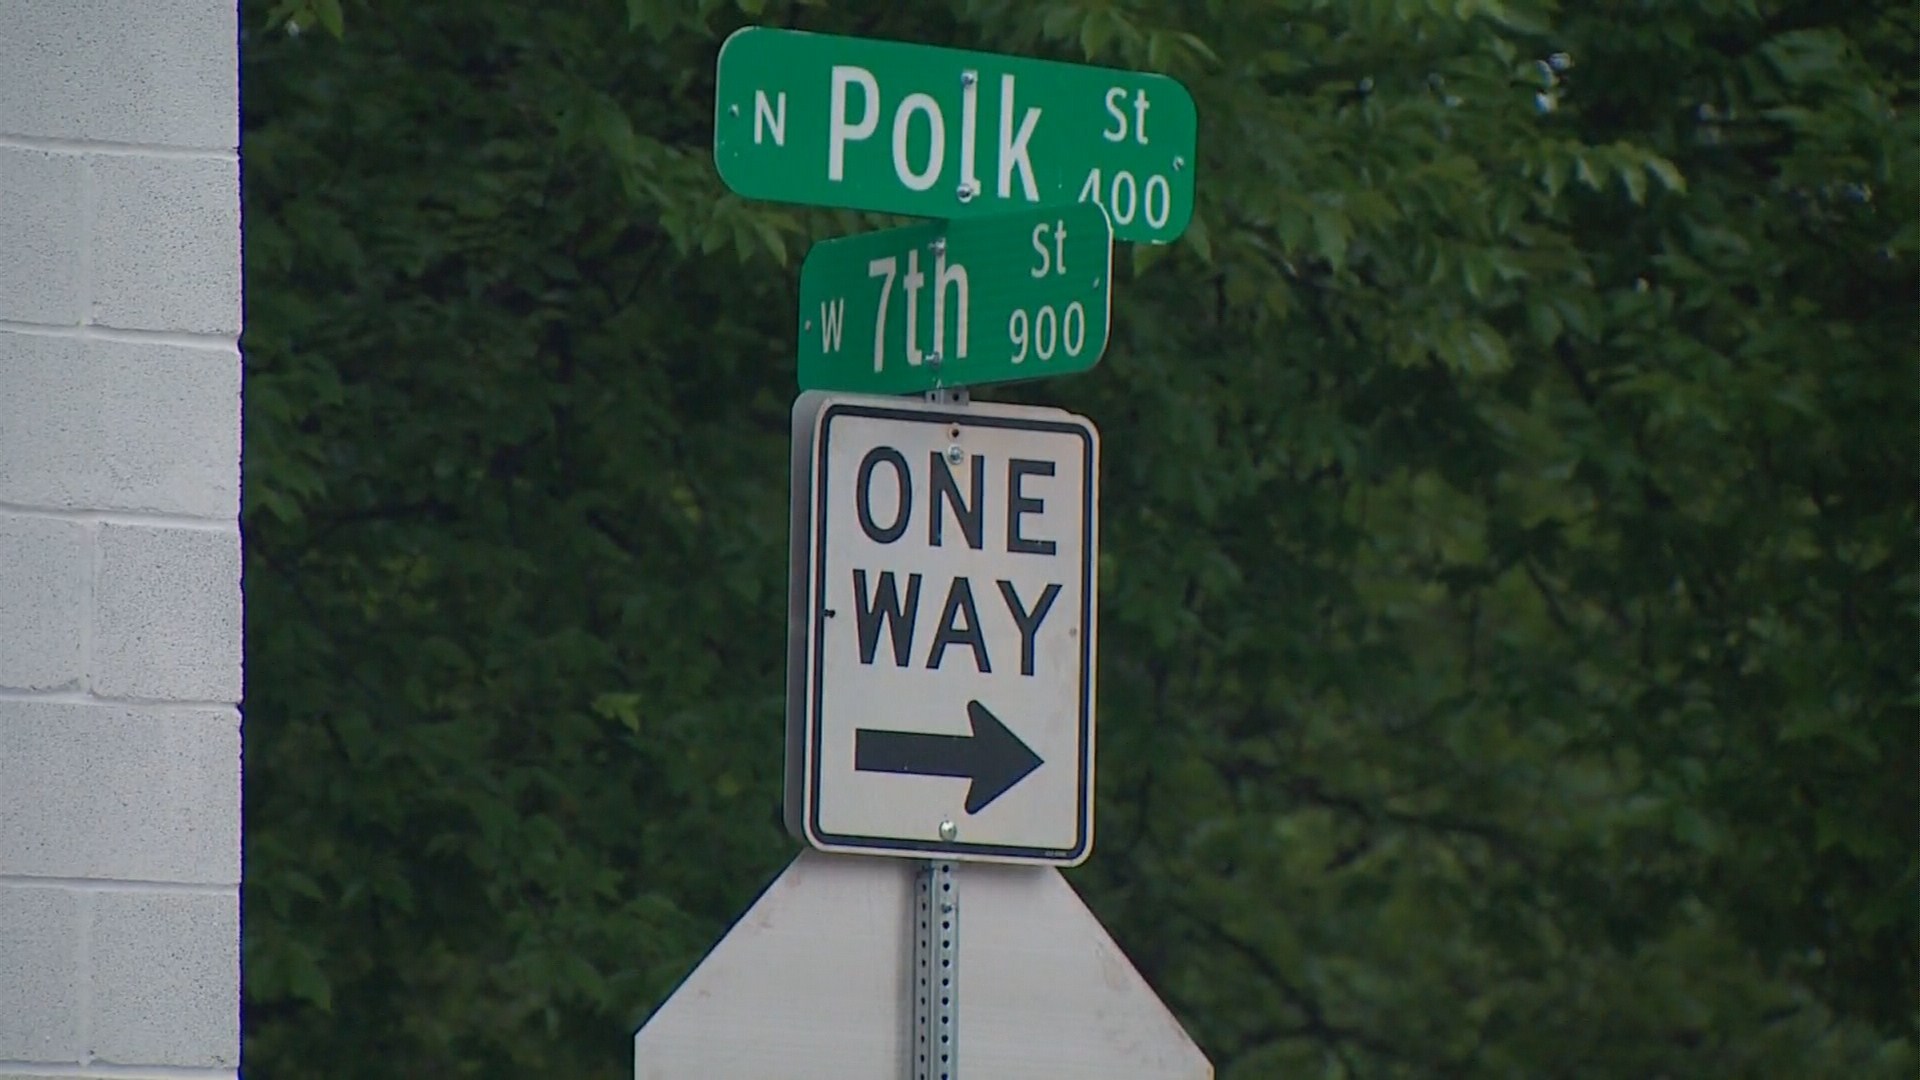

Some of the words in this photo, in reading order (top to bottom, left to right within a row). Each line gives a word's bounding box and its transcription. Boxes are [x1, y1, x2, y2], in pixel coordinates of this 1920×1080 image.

[754, 90, 786, 146] N
[828, 65, 1042, 202] Polk
[1103, 86, 1150, 144] St
[820, 298, 844, 353] W
[868, 238, 969, 373] 7th
[1031, 219, 1067, 279] St
[1009, 302, 1085, 363] 900
[855, 446, 1056, 556] ONE
[852, 568, 1063, 677] WAY
